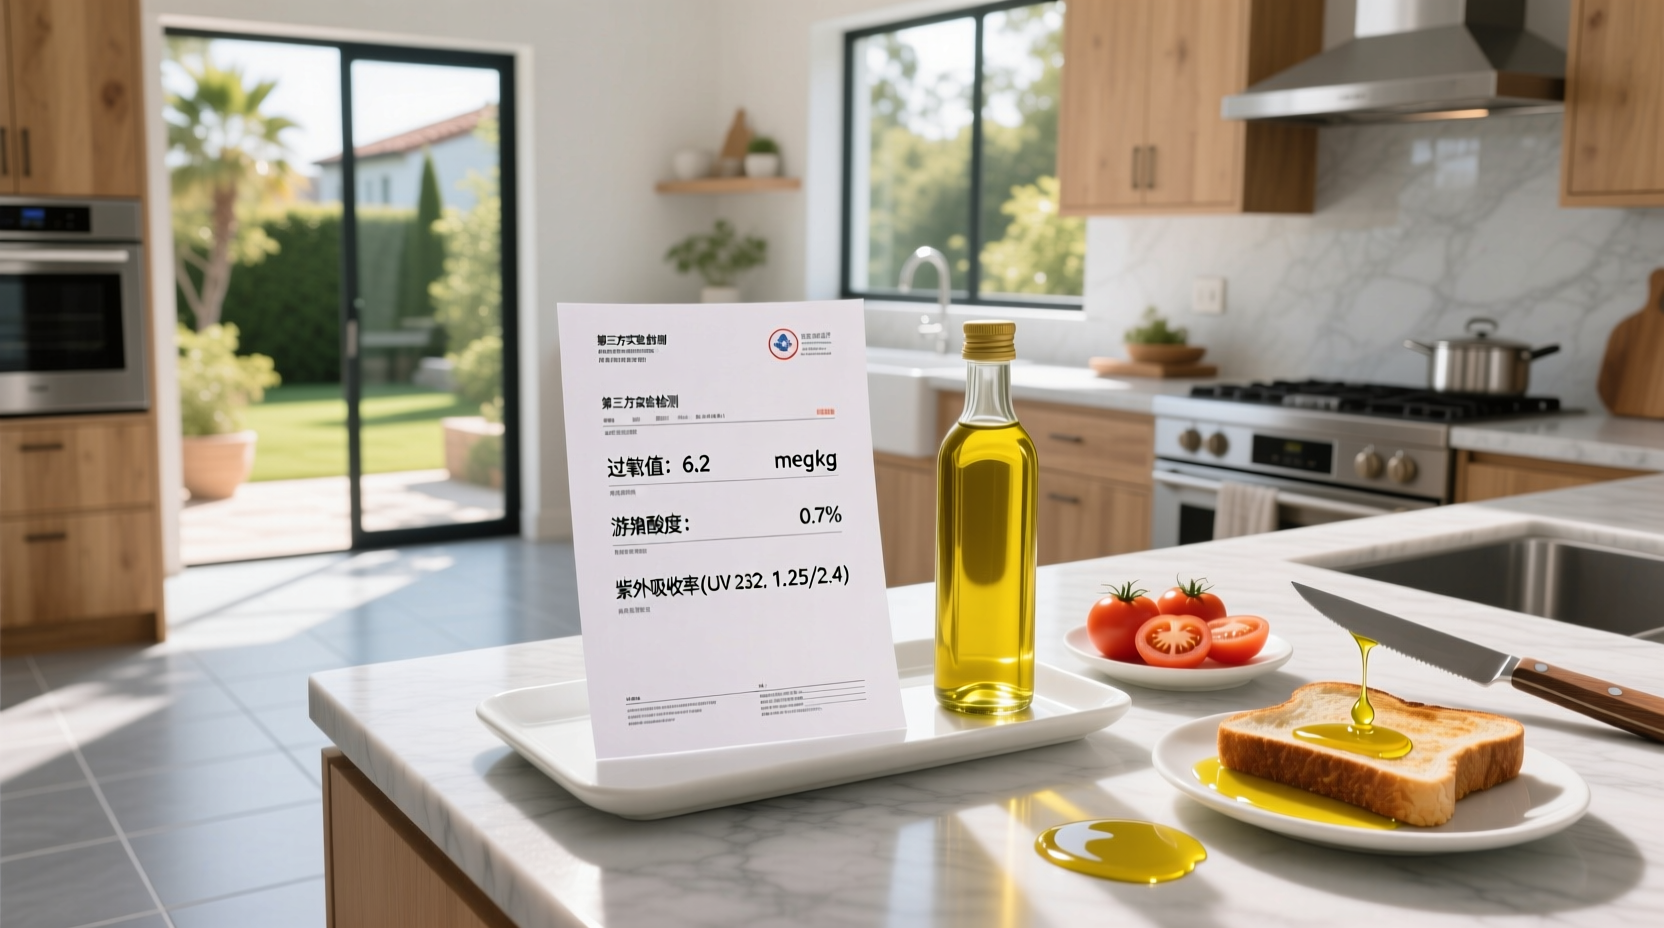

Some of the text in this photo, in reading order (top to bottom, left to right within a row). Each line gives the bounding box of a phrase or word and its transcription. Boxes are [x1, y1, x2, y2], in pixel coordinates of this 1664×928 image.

[682, 454, 710, 473] 6.2
[774, 449, 837, 472] megkg
[799, 505, 842, 524] 0.7%
